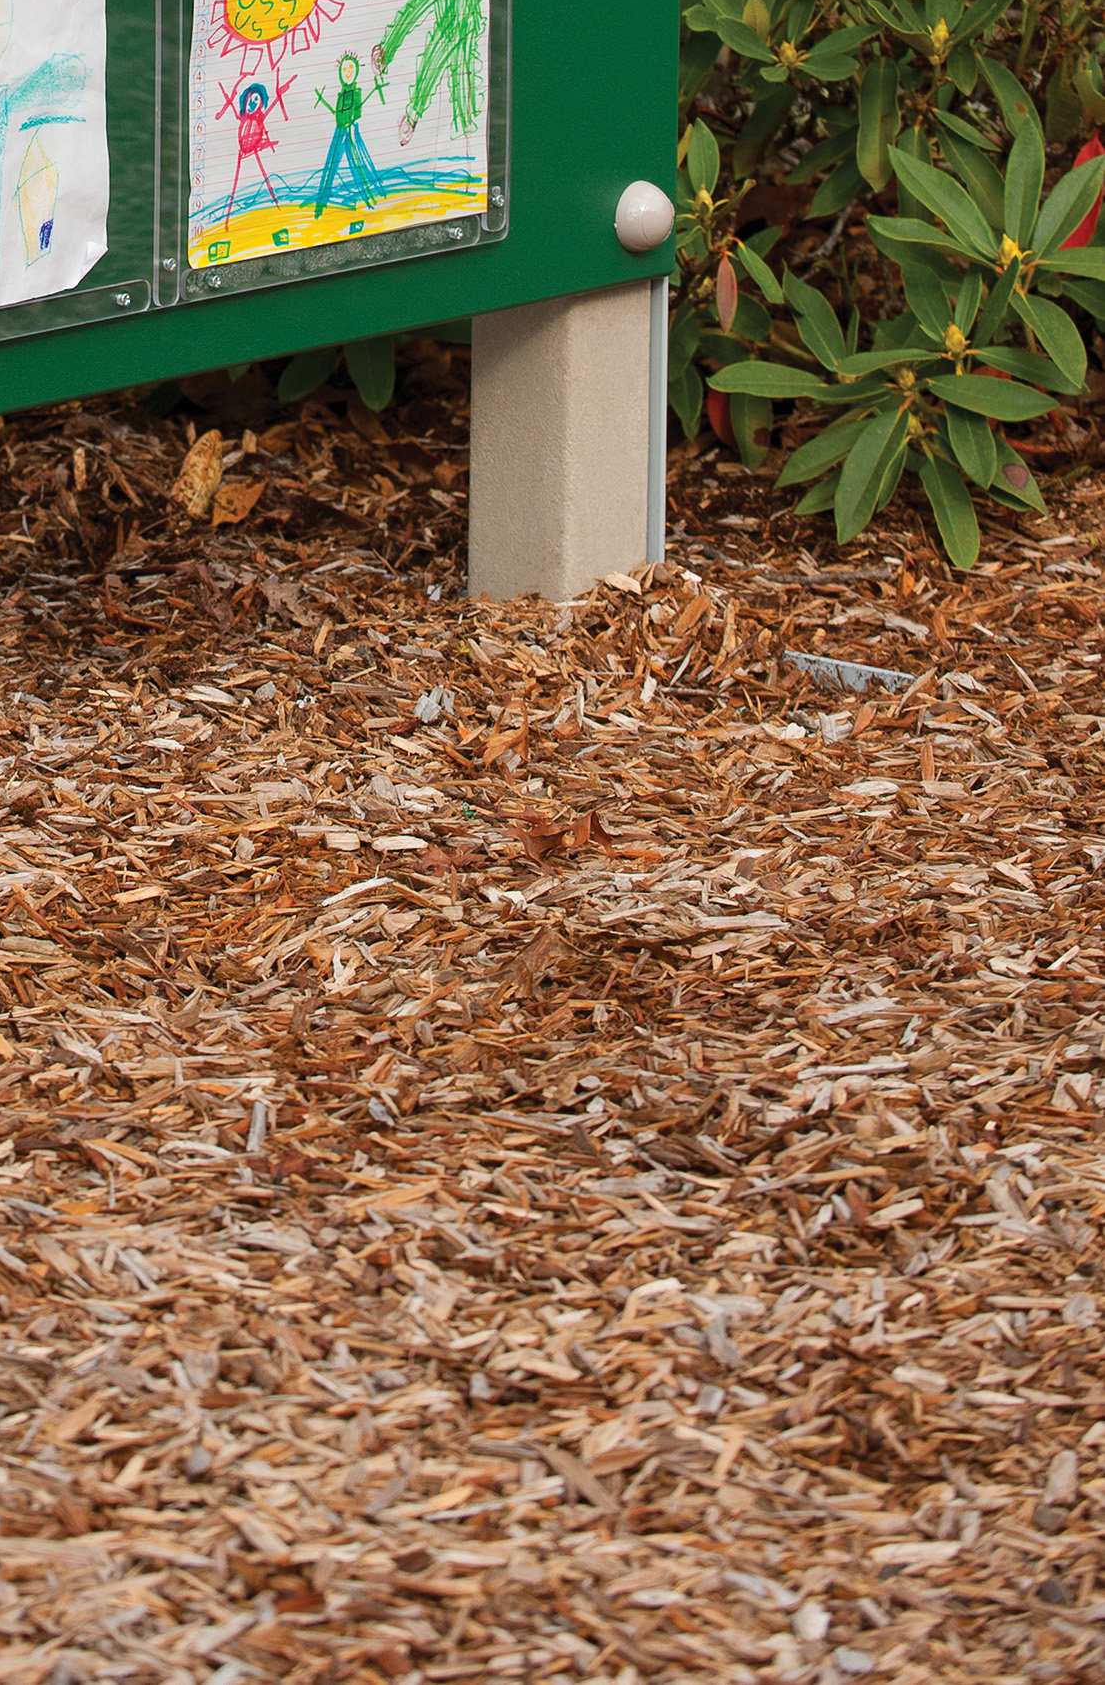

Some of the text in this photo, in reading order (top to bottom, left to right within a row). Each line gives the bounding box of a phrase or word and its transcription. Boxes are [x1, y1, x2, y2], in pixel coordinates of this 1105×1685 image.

[200, 19, 206, 32] 2
[197, 45, 203, 57] 3
[196, 71, 202, 81] 4
[196, 98, 202, 108] 5
[196, 125, 203, 134] 6
[196, 149, 202, 159] 7
[195, 175, 201, 185] 8
[195, 200, 202, 210] 9
[194, 226, 203, 237] 10
